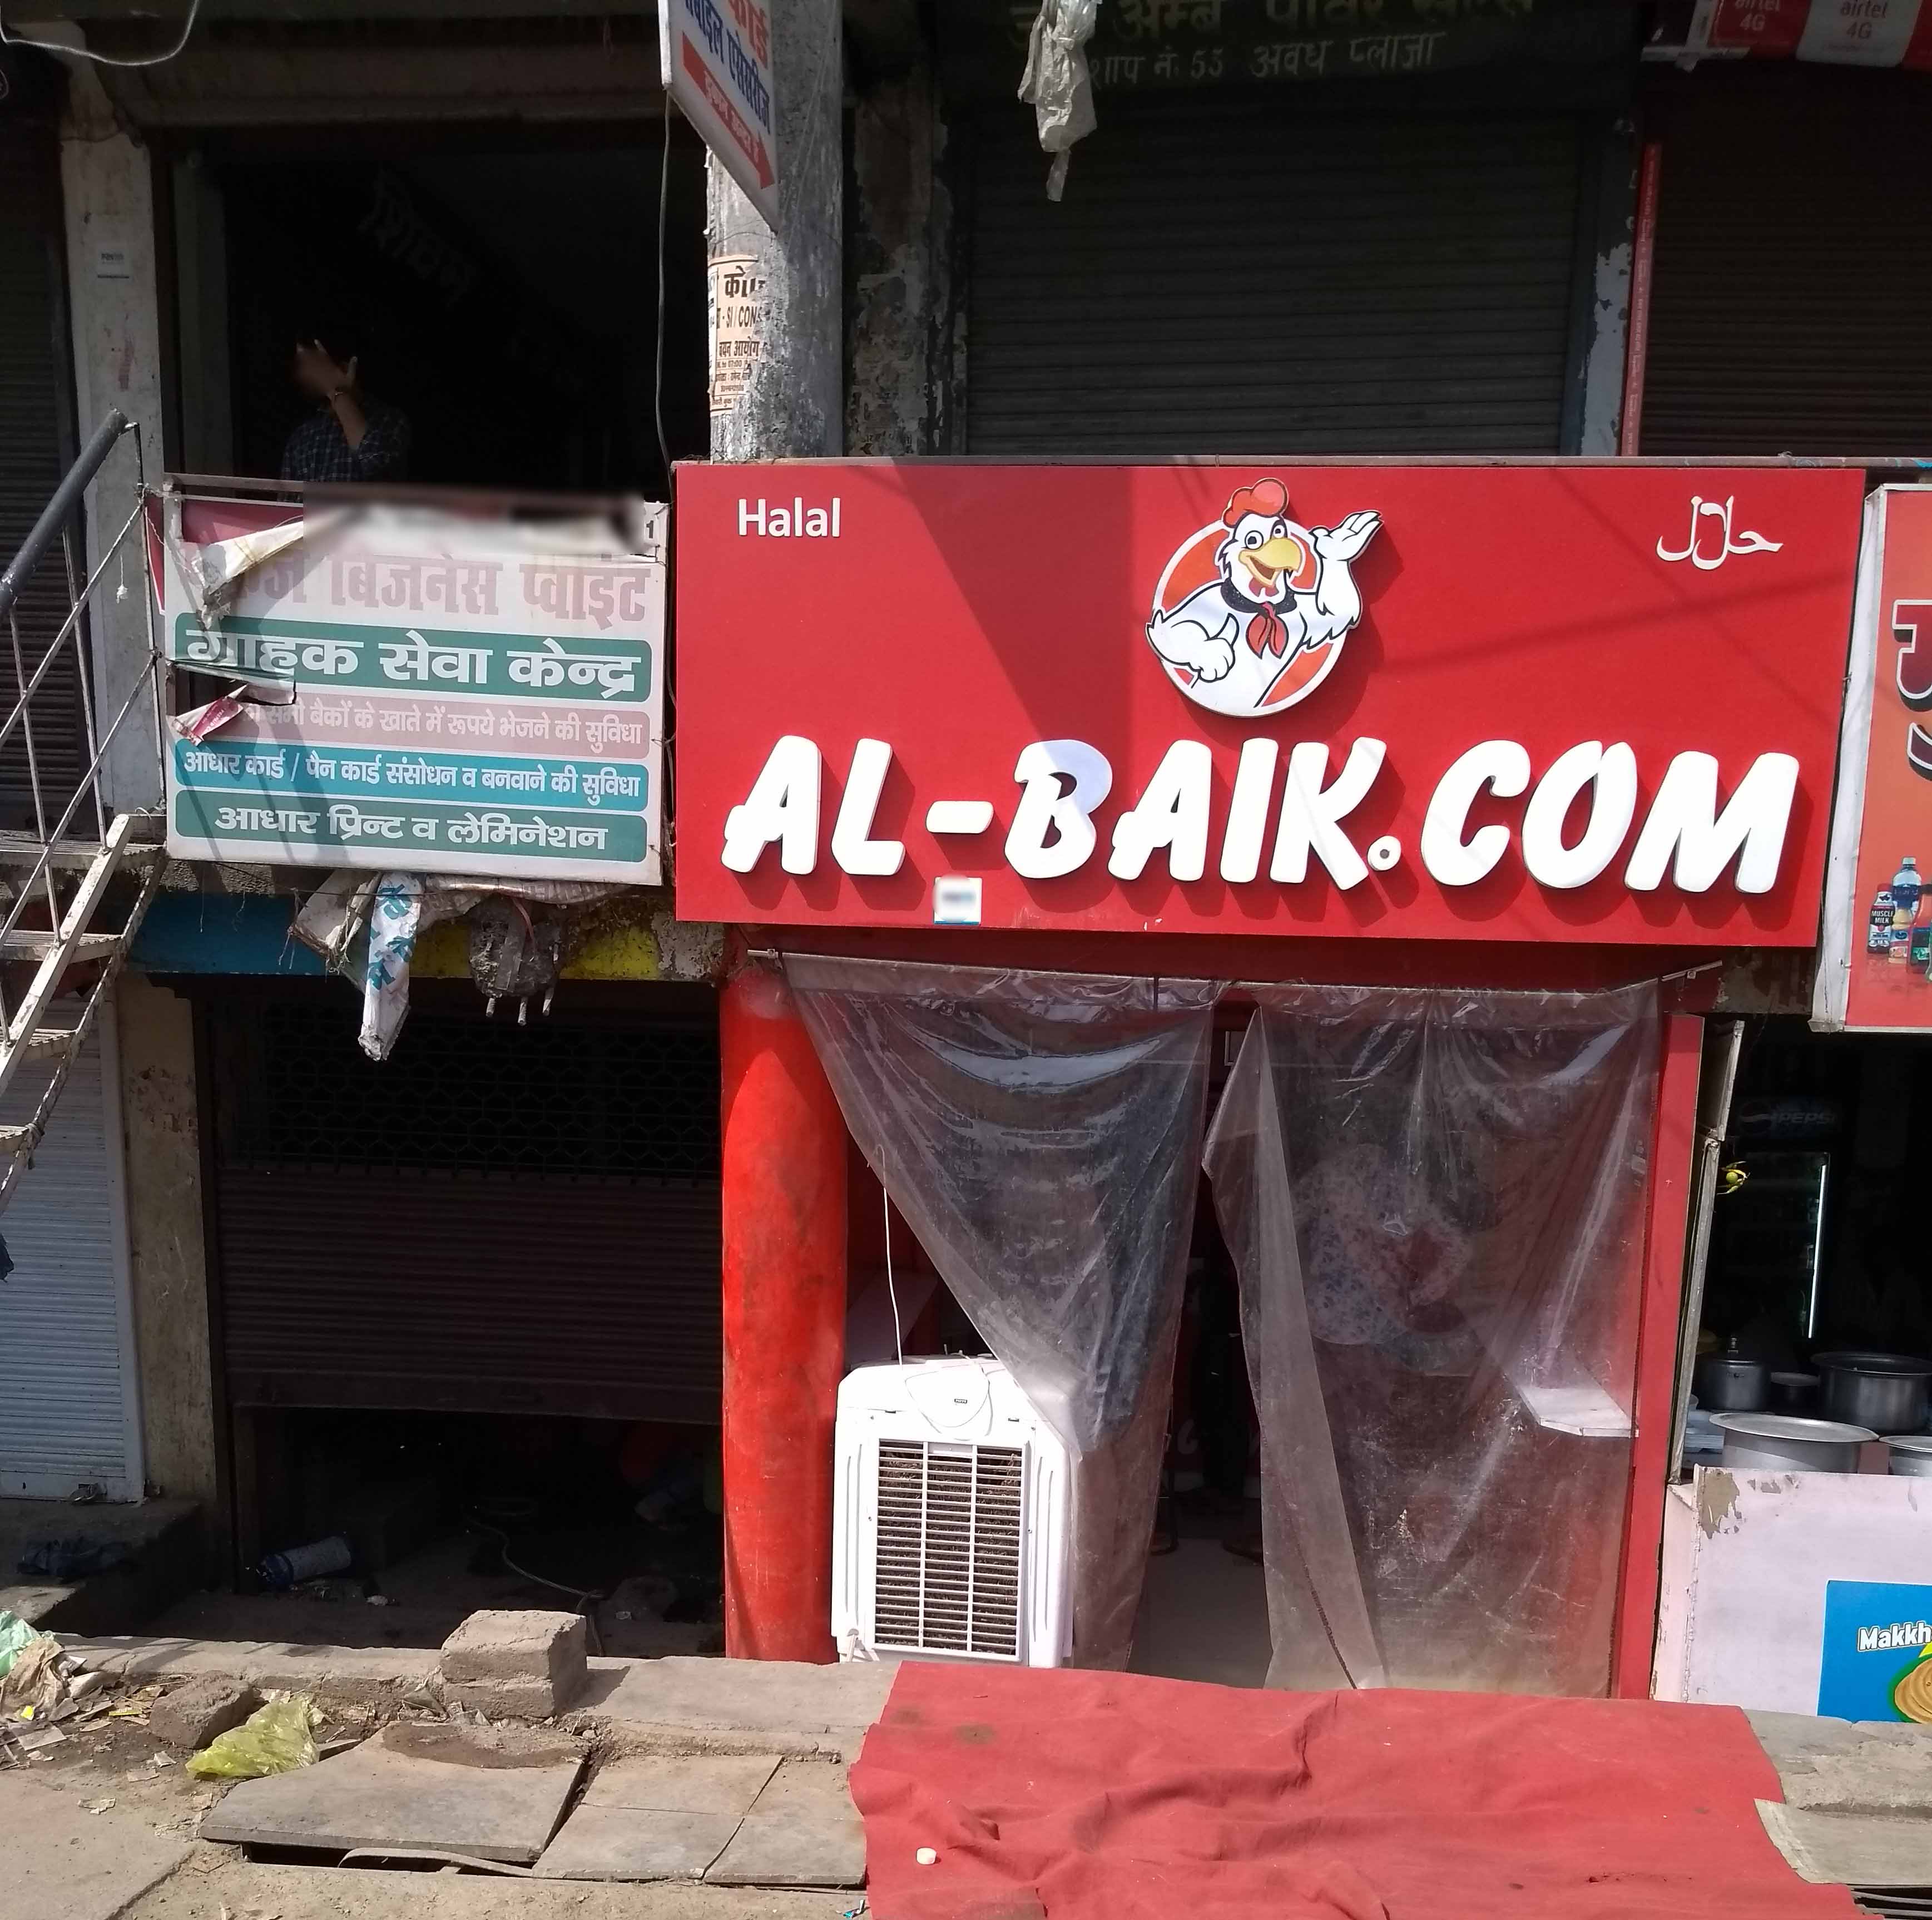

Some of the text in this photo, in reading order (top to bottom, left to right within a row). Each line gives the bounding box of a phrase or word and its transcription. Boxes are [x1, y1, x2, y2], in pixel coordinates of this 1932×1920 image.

[1740, 13, 1766, 31] 4G
[1840, 0, 1887, 18] airtel
[1846, 22, 1872, 39] 4G
[1250, 41, 1335, 77] अवध
[1350, 31, 1447, 70] प्लाजा
[738, 497, 840, 537] Halal
[1656, 495, 1784, 570] حلال
[378, 630, 494, 684] सेवा
[507, 638, 642, 699] केन्द्र
[354, 700, 375, 729] के
[379, 704, 422, 733] खाते
[425, 705, 445, 733] में
[500, 710, 551, 739] भेजने
[555, 712, 582, 741] की
[585, 714, 642, 753] सुविधा
[184, 751, 241, 775] आधार
[245, 748, 286, 778] कार्ड
[341, 754, 382, 784] कार्ड
[385, 756, 458, 786] संसोधन
[462, 767, 477, 788] व
[481, 764, 547, 792] बनवाने
[551, 764, 578, 793] की
[582, 766, 641, 806] सुविधा
[214, 804, 609, 850] आधार प्रिन्ट व लेमिनेशन
[721, 735, 1800, 894] AL-BAIK.COM
[1858, 1621, 1932, 1652] Makkh
